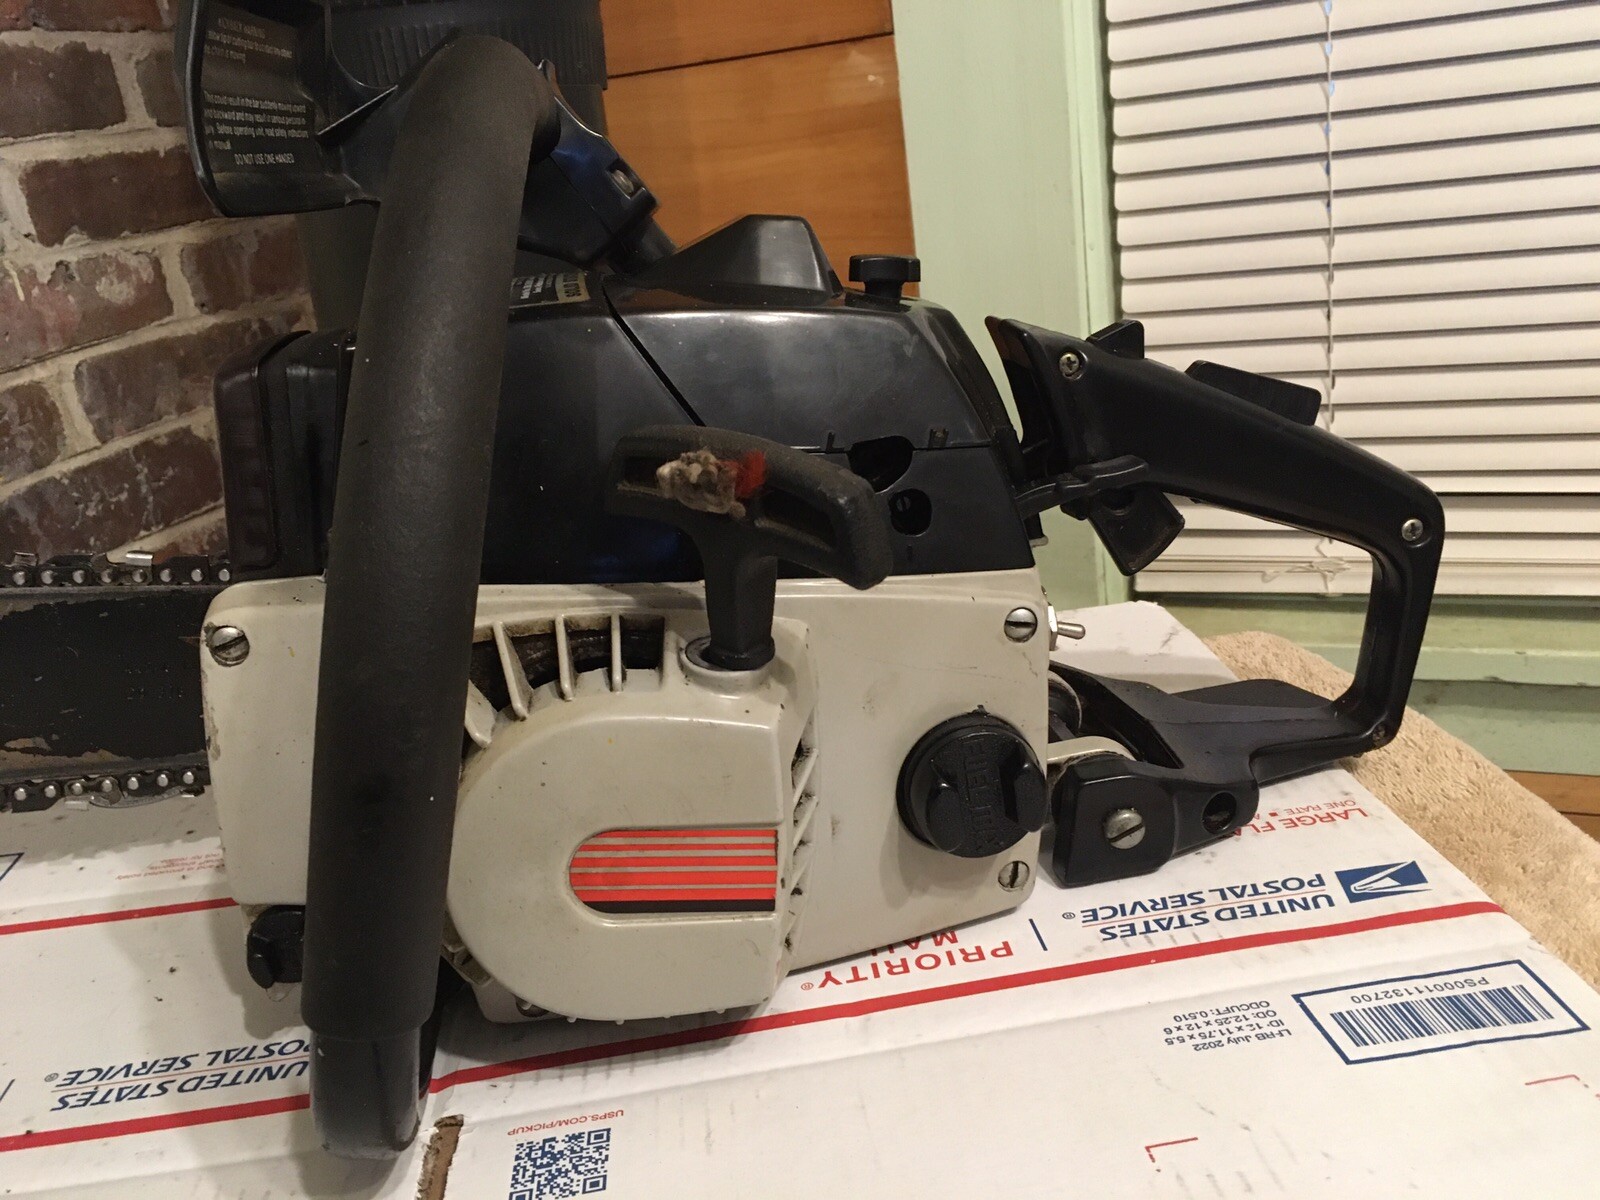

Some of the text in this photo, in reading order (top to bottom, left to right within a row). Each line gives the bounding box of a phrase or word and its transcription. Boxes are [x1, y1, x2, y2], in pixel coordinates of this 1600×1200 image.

[1283, 799, 1357, 816] ONE RATE
[1278, 807, 1368, 829] LARGE
[1209, 873, 1326, 901] POSTAL
[1099, 894, 1335, 941] UNITED STATES
[1350, 976, 1490, 1004] PS00011132700
[1173, 1000, 1271, 1023] ODCUFT: 0.510
[1251, 1009, 1278, 1019] OD:
[1186, 1021, 1202, 1030] 12
[1214, 1013, 1250, 1026] 12.25
[1163, 1027, 1173, 1035] 6
[1200, 1027, 1235, 1040] 11.75
[1164, 1035, 1186, 1046] 5.5
[1192, 1039, 1225, 1051] 2022
[1226, 1035, 1252, 1045] July
[50, 1060, 309, 1112] UNITED STATES
[507, 1109, 624, 1136] USPS.COM/PICKUP
